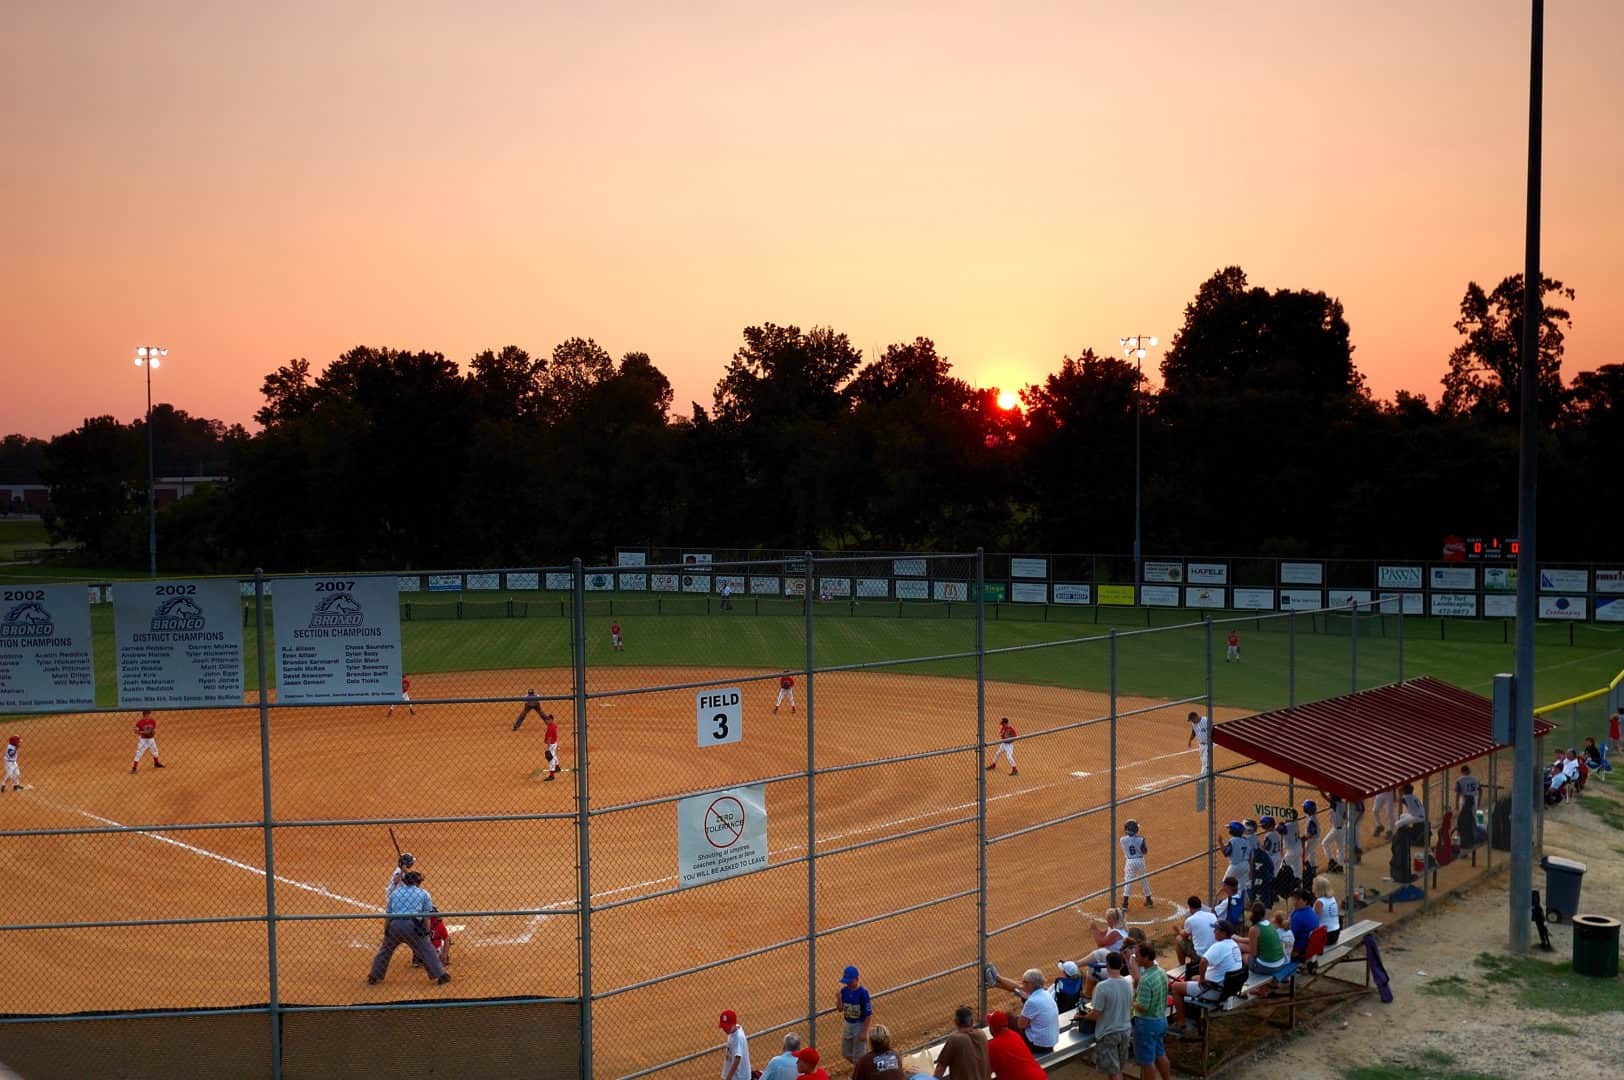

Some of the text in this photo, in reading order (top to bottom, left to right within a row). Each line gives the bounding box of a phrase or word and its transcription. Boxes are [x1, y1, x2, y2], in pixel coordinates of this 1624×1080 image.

[1474, 542, 1482, 553] 0
[1381, 567, 1421, 580] PAWN
[155, 585, 196, 595] 2002
[315, 582, 355, 591] 2007
[4, 590, 45, 601] 2002
[151, 617, 204, 631] BRONCO
[312, 614, 362, 626] BRONCO
[1, 624, 52, 636] BRONCO
[293, 627, 382, 639] SECTION CHAMPIONS
[133, 631, 224, 642] DISTRICT CHAMPIONS
[21, 638, 72, 648] CHAMPIONS
[700, 693, 739, 709] FIELD
[713, 713, 729, 739] 3
[706, 819, 745, 834] TOLERANCE
[697, 850, 723, 861] Shouting
[1128, 845, 1136, 856] 6
[1240, 846, 1248, 857] 7
[718, 855, 737, 866] players
[683, 855, 766, 881] YOU WILL BE ASKED TO LEAVE
